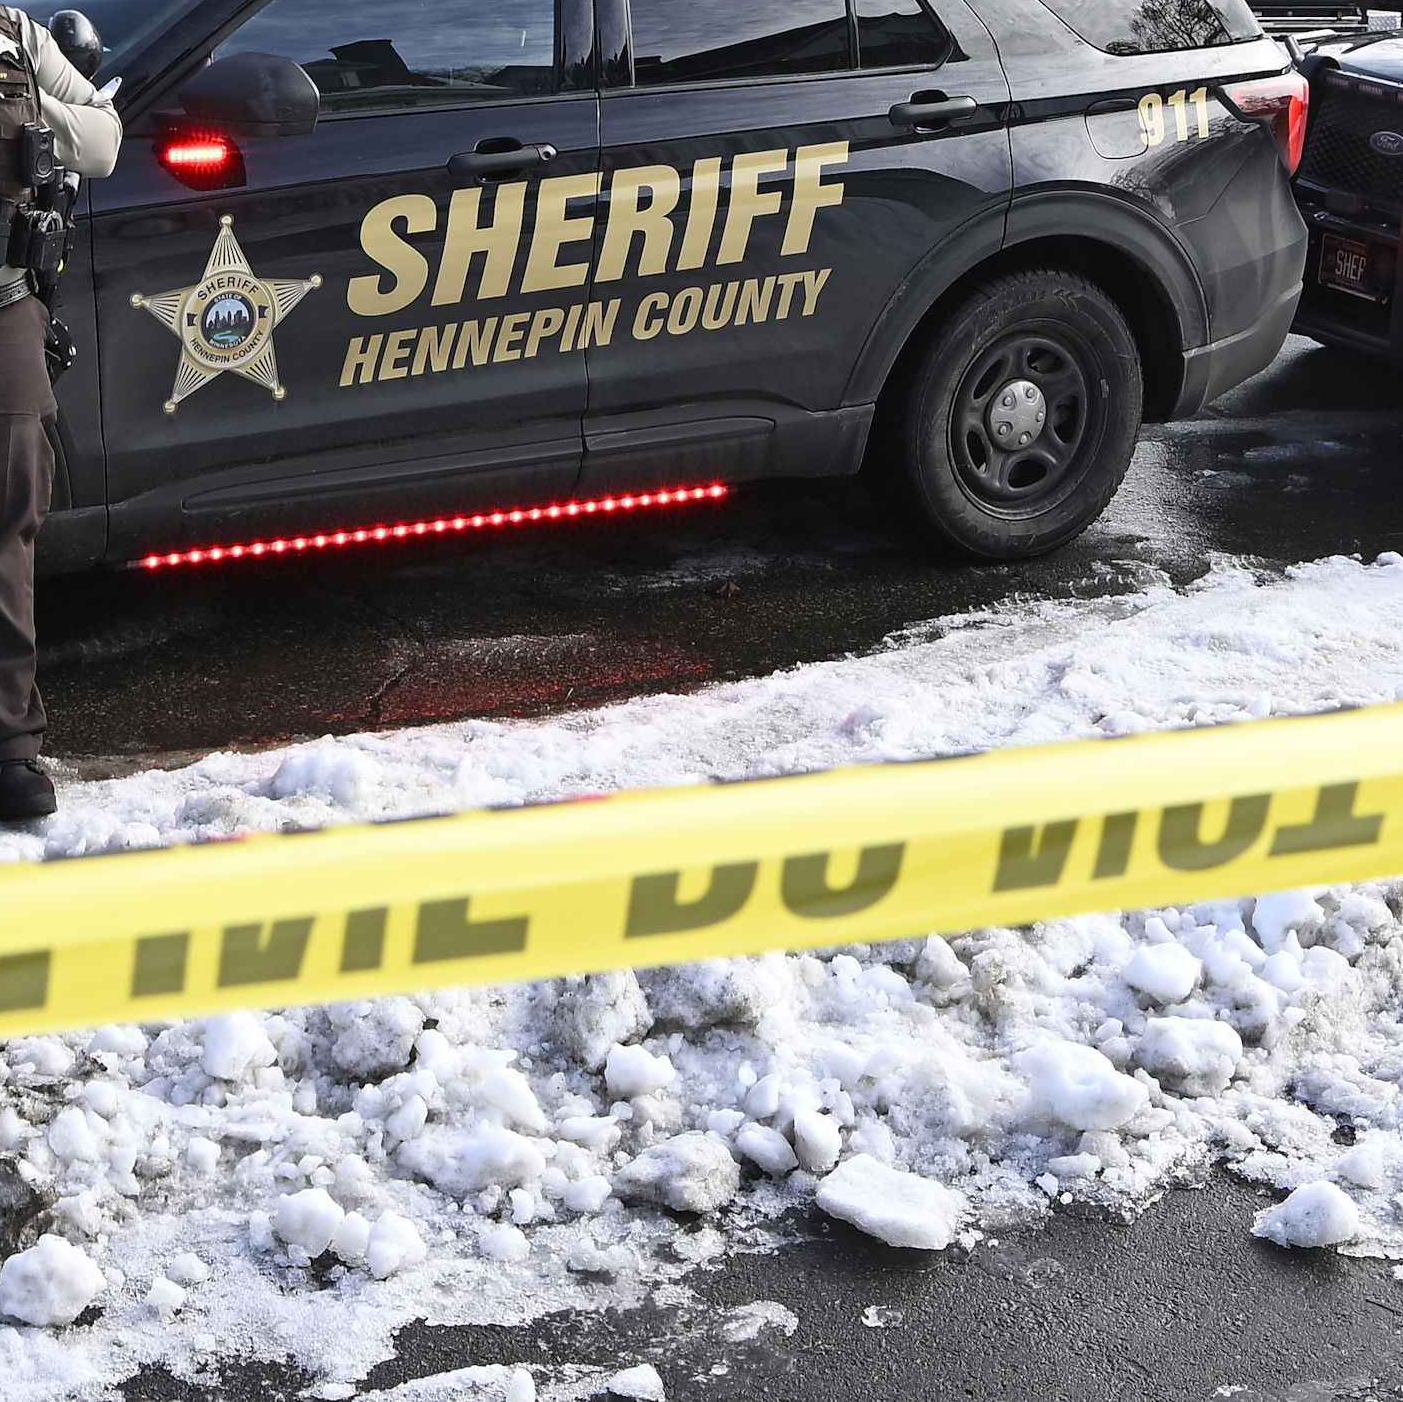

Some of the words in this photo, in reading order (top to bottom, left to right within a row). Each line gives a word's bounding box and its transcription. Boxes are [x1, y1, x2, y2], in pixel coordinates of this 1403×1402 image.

[1138, 87, 1210, 146] 911
[346, 140, 850, 317] SHERIFF
[198, 276, 259, 301] SHERIFF
[214, 293, 232, 303] STATE
[233, 293, 243, 301] OF
[209, 336, 247, 349] MINNESOTA
[339, 299, 621, 387] HENNEPIN
[631, 269, 832, 340] COUNTY
[190, 337, 230, 363] HENNEPIN
[232, 330, 264, 361] COUNTY
